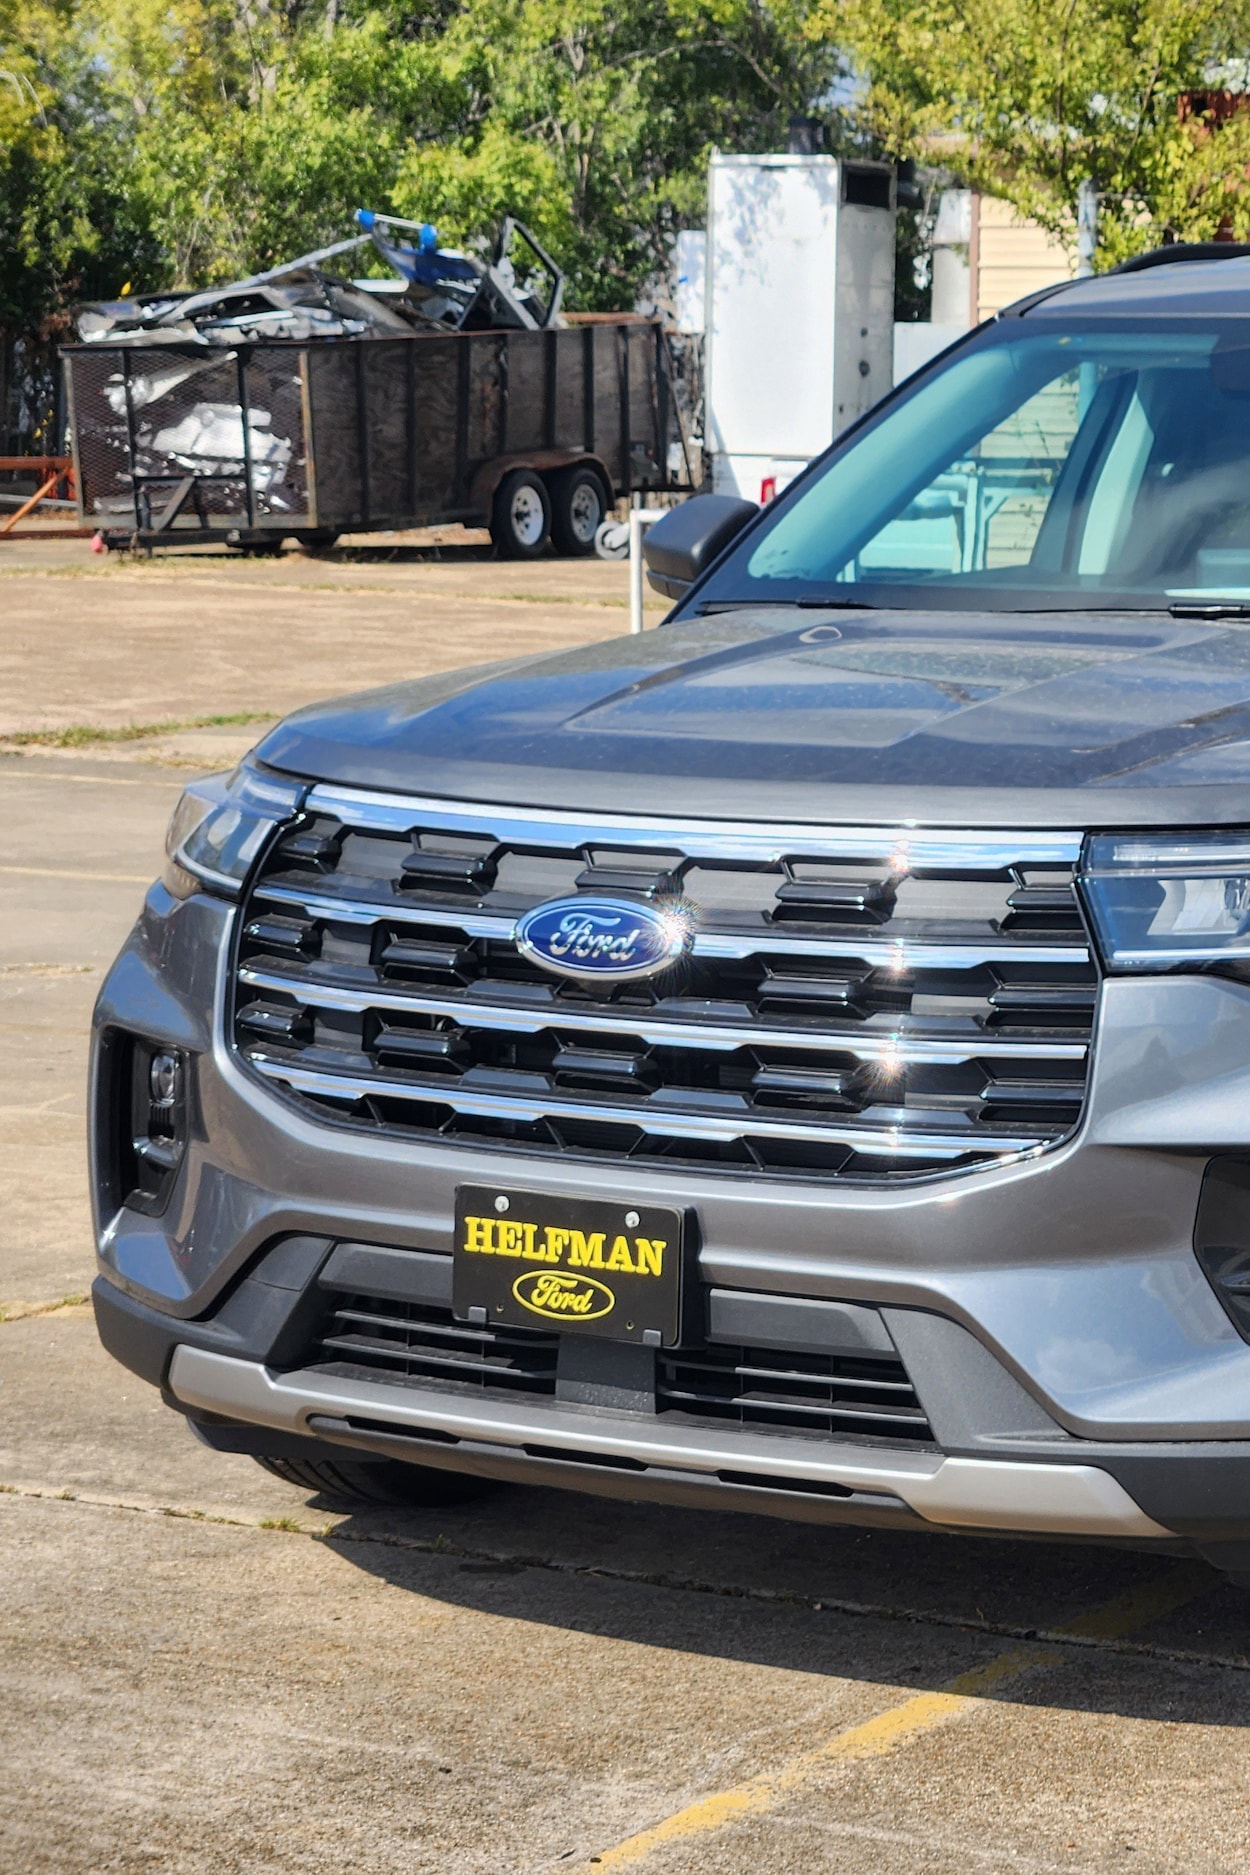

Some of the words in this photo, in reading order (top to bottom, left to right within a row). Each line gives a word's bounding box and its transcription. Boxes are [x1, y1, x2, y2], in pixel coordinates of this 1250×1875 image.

[550, 912, 640, 961] Ford
[463, 1216, 667, 1277] HELFMAN
[530, 1275, 593, 1313] Ford
